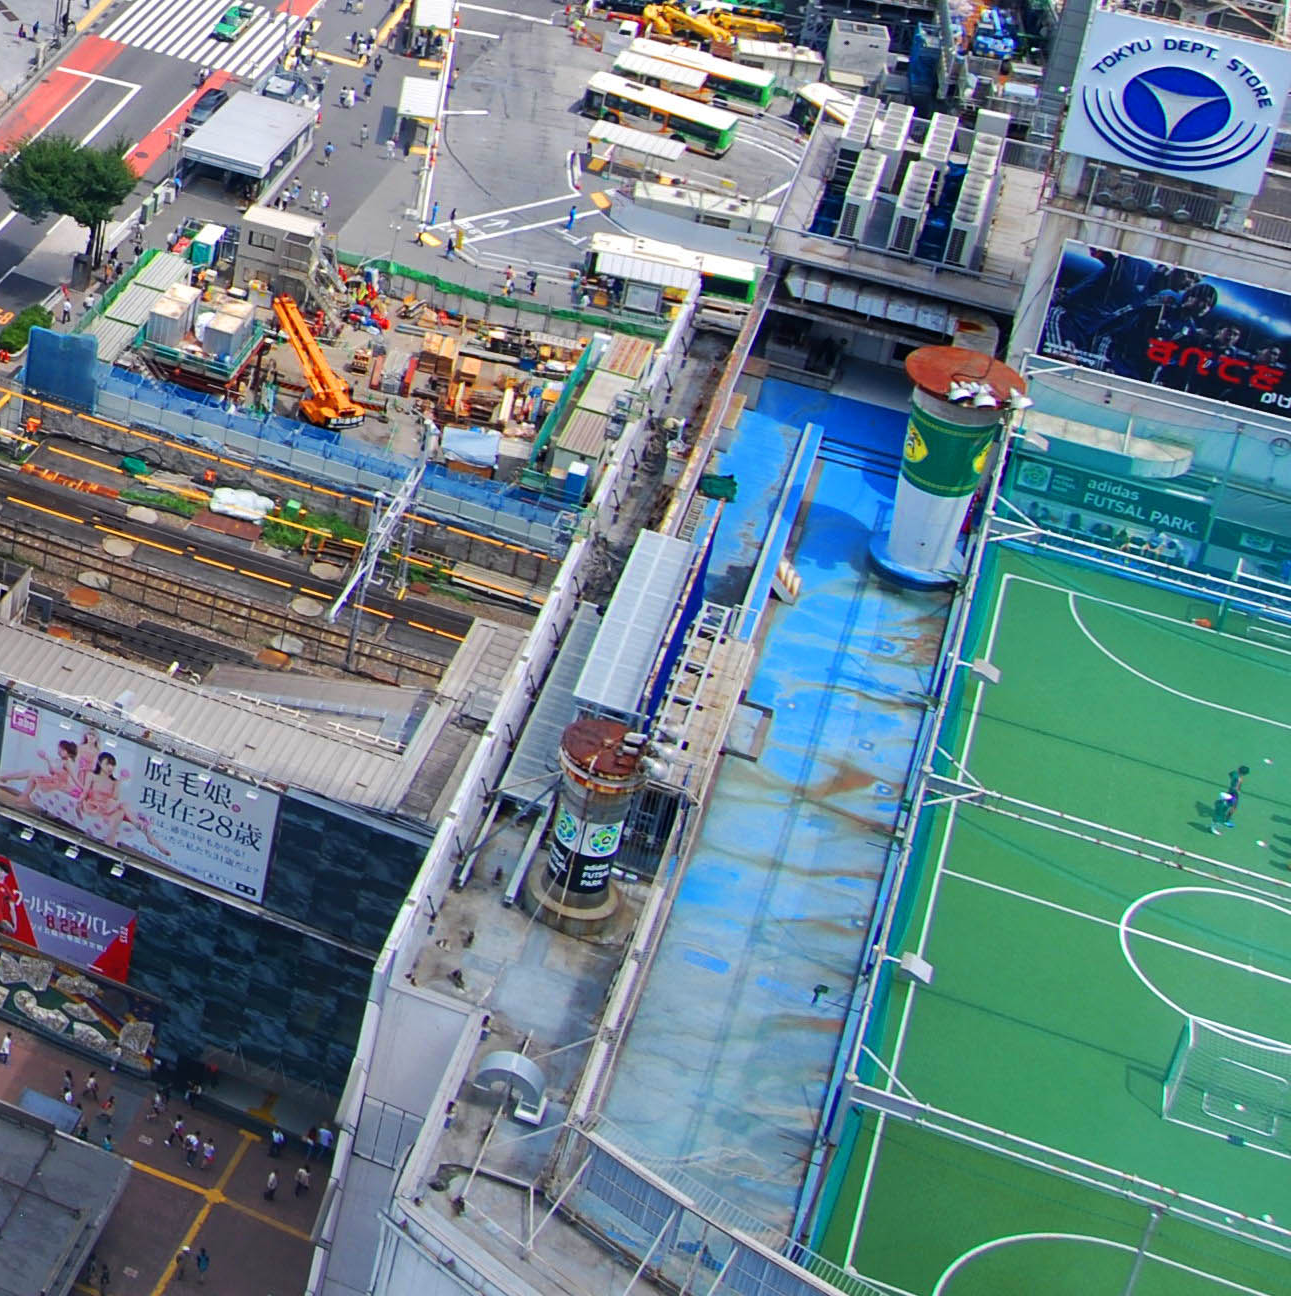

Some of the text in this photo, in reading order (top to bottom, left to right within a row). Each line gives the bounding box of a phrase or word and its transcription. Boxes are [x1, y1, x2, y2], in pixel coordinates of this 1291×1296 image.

[1091, 37, 1274, 109] TOKYU DEPT. STORE
[1082, 492, 1147, 521] FUTSAL
[1087, 478, 1140, 502] adidas
[139, 786, 263, 852] 現在28歳
